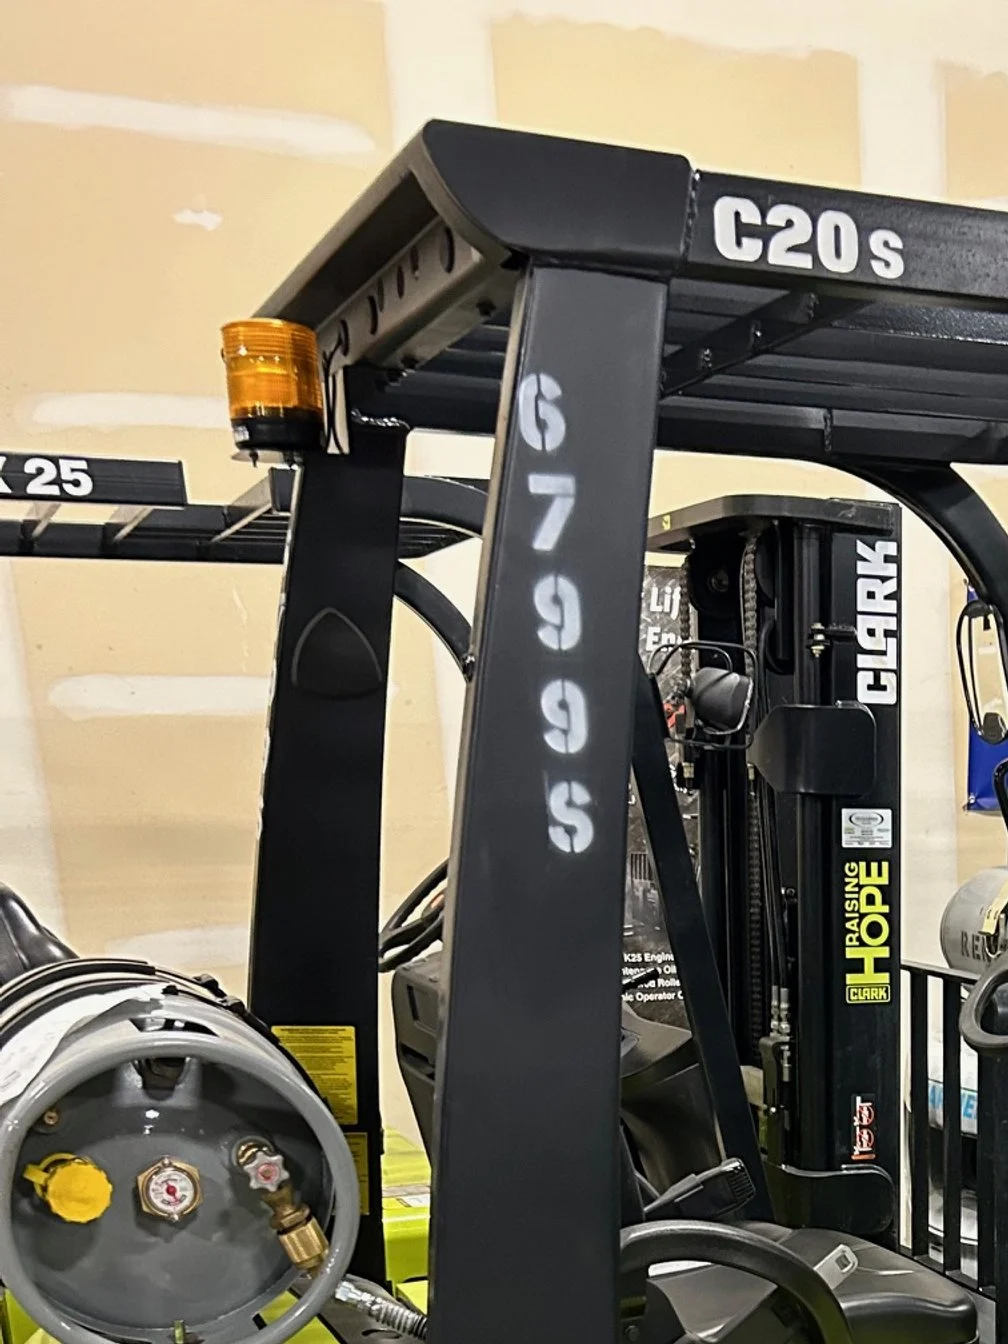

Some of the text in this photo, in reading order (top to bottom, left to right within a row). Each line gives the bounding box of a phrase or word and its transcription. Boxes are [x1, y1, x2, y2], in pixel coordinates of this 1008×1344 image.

[714, 195, 859, 274] C20
[23, 457, 94, 497] 25
[518, 372, 595, 855] 6799S
[856, 539, 898, 705] CLARK
[844, 861, 860, 947] RAISING
[845, 861, 890, 985] HOPE
[850, 987, 887, 1001] CLARK
